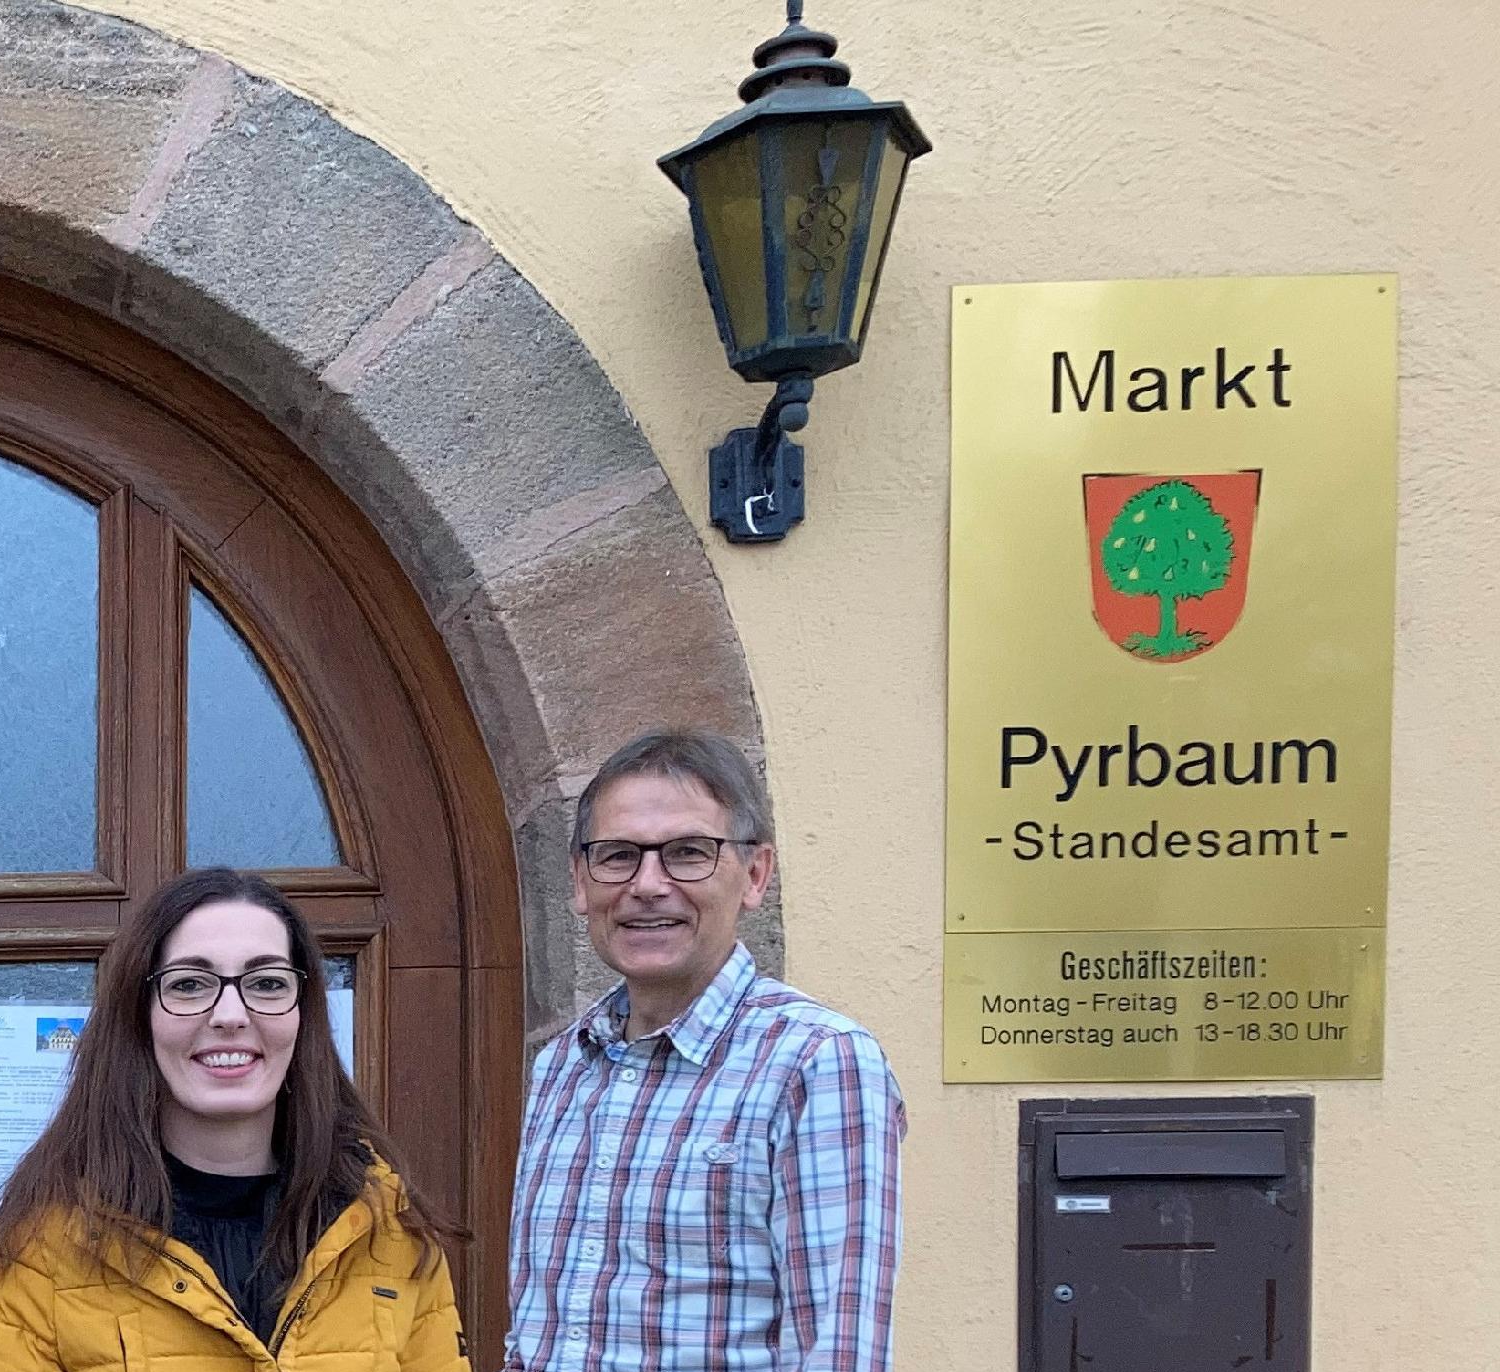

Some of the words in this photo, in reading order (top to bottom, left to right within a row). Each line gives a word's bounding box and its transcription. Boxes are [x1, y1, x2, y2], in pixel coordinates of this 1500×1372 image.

[1051, 346, 1292, 414] Markt
[1001, 724, 1337, 803] Pyrbaum
[1061, 949, 1267, 981] Geschäftszeiten:
[1307, 990, 1350, 1010] Uhr
[981, 1025, 1114, 1048] Donnerstag
[1123, 1024, 1178, 1043] auch
[1306, 1021, 1349, 1041] Uhr
